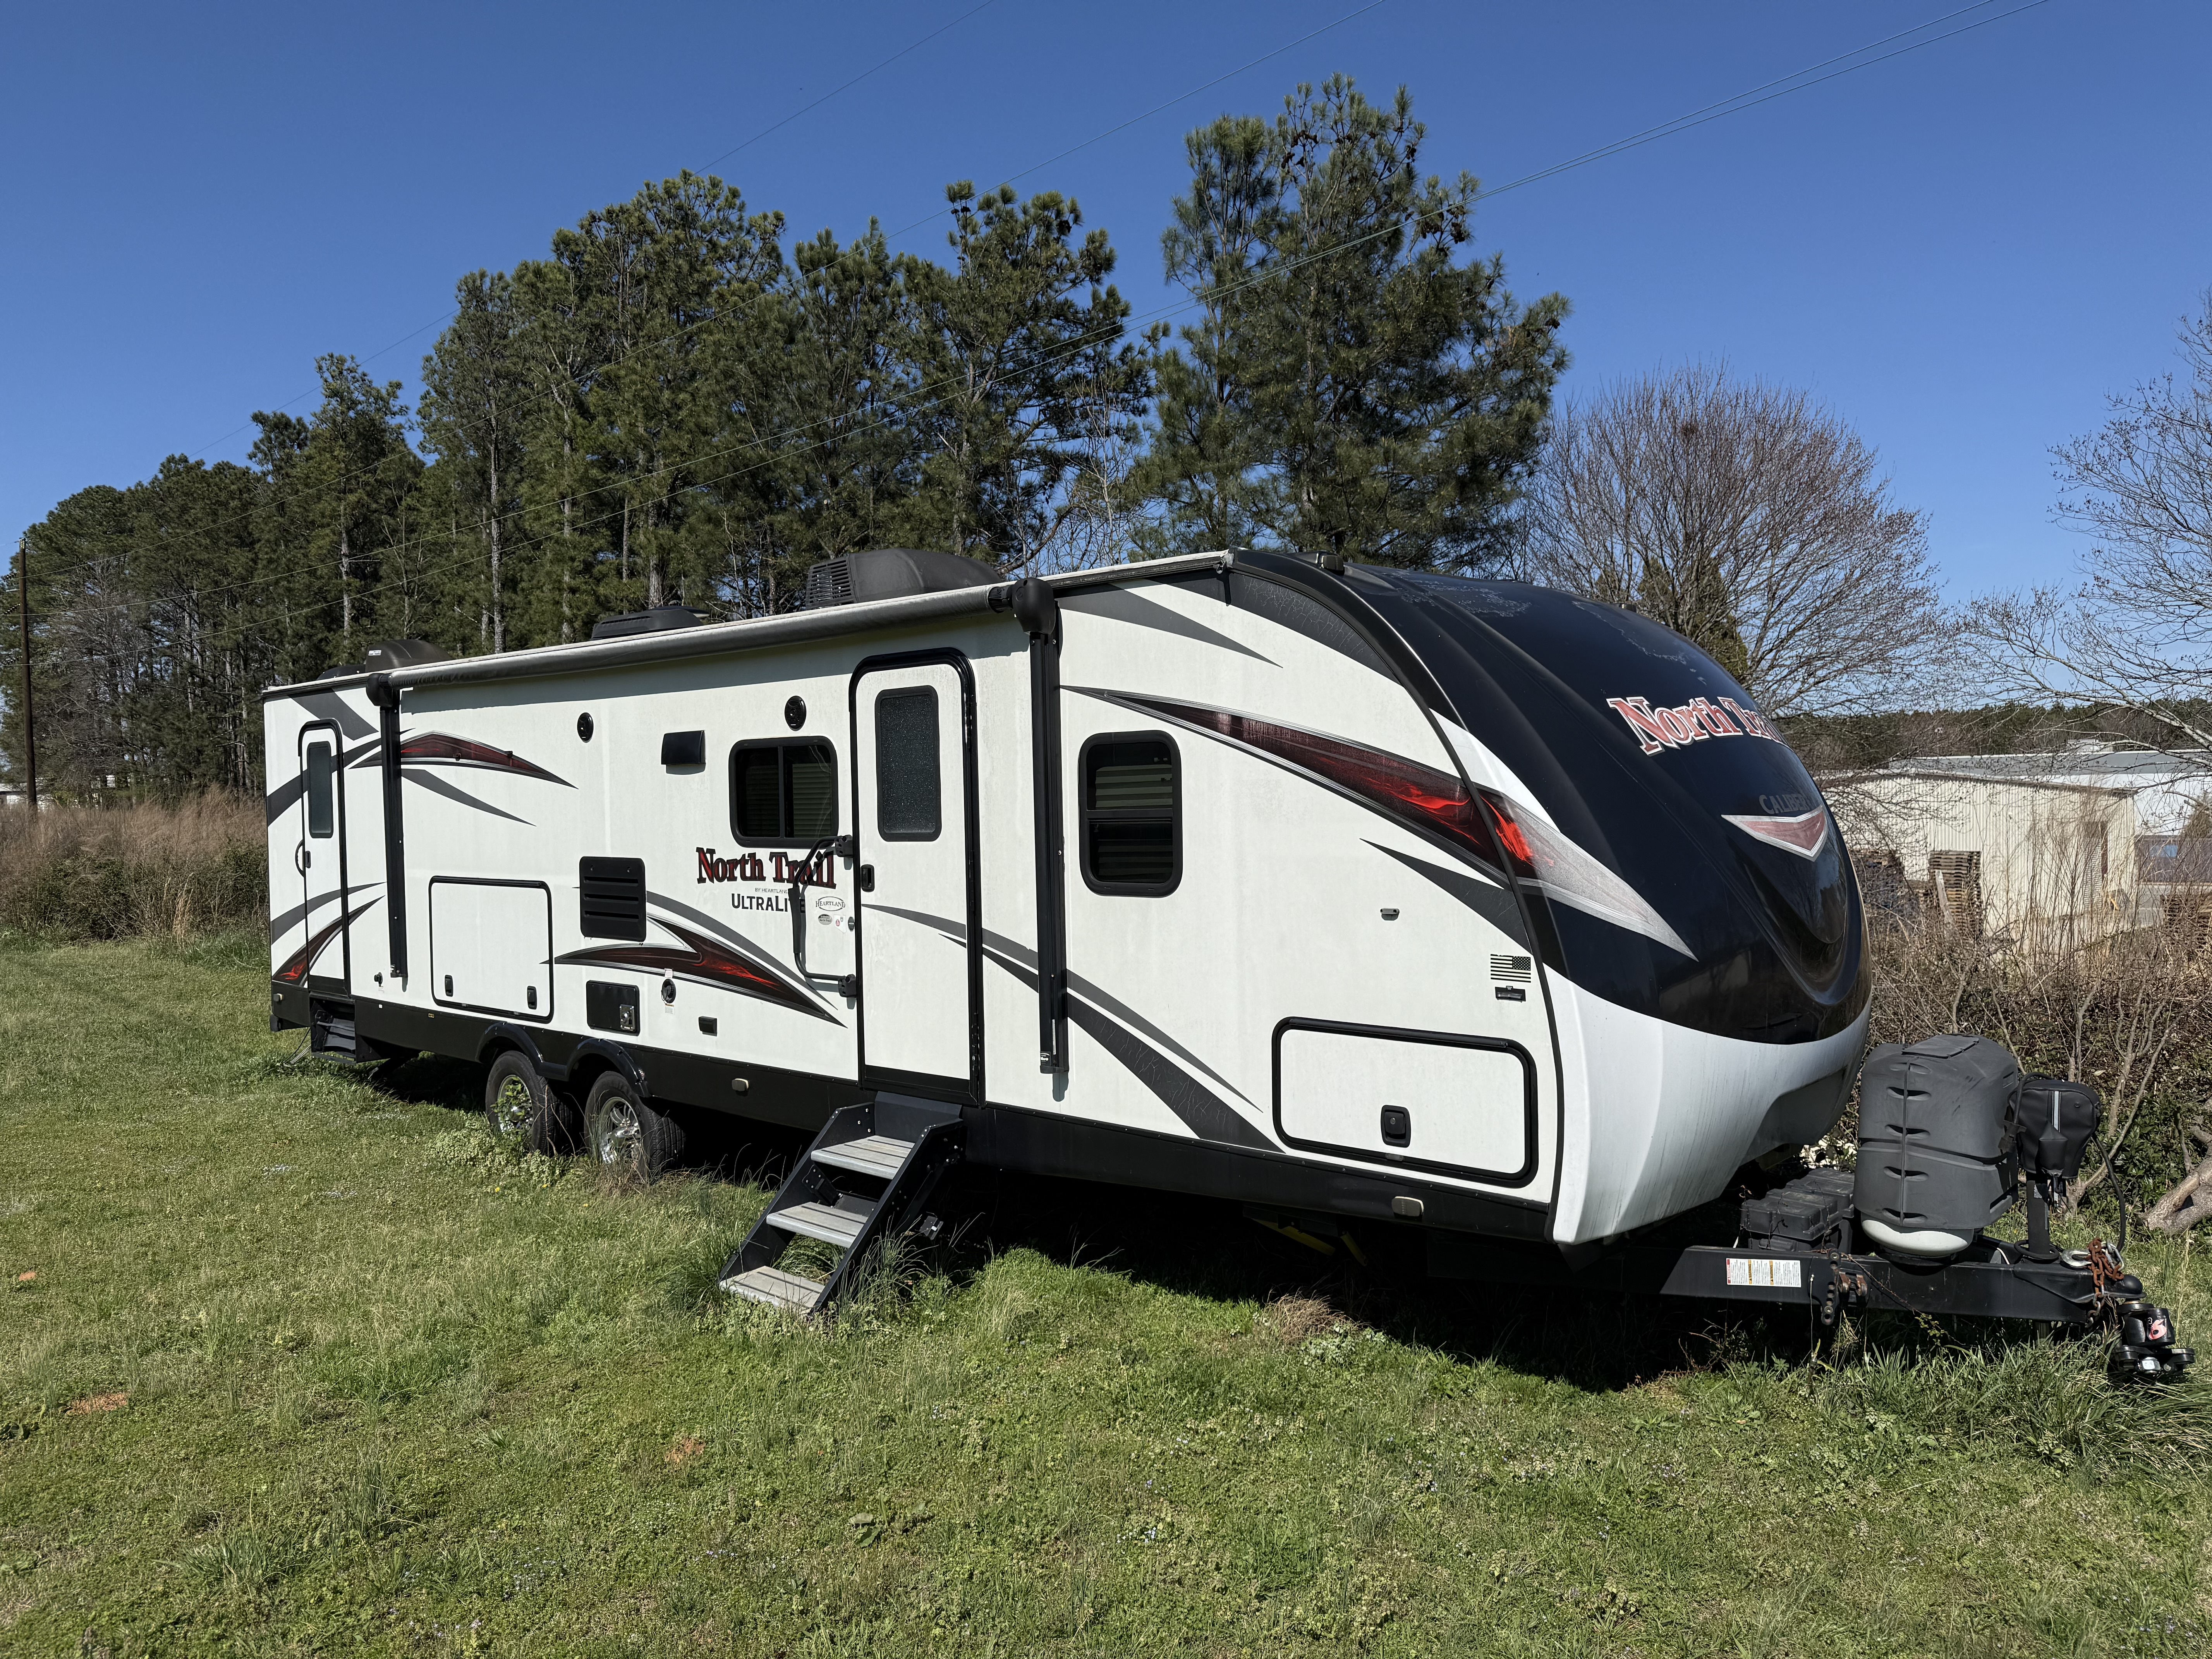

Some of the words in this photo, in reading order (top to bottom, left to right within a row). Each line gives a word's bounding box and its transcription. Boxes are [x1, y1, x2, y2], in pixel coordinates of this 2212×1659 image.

[1606, 696, 1743, 756] North
[1759, 793, 1810, 814] CALIBER
[696, 847, 766, 884] North
[769, 850, 837, 889] Trail
[732, 893, 805, 913] ULTRALIE
